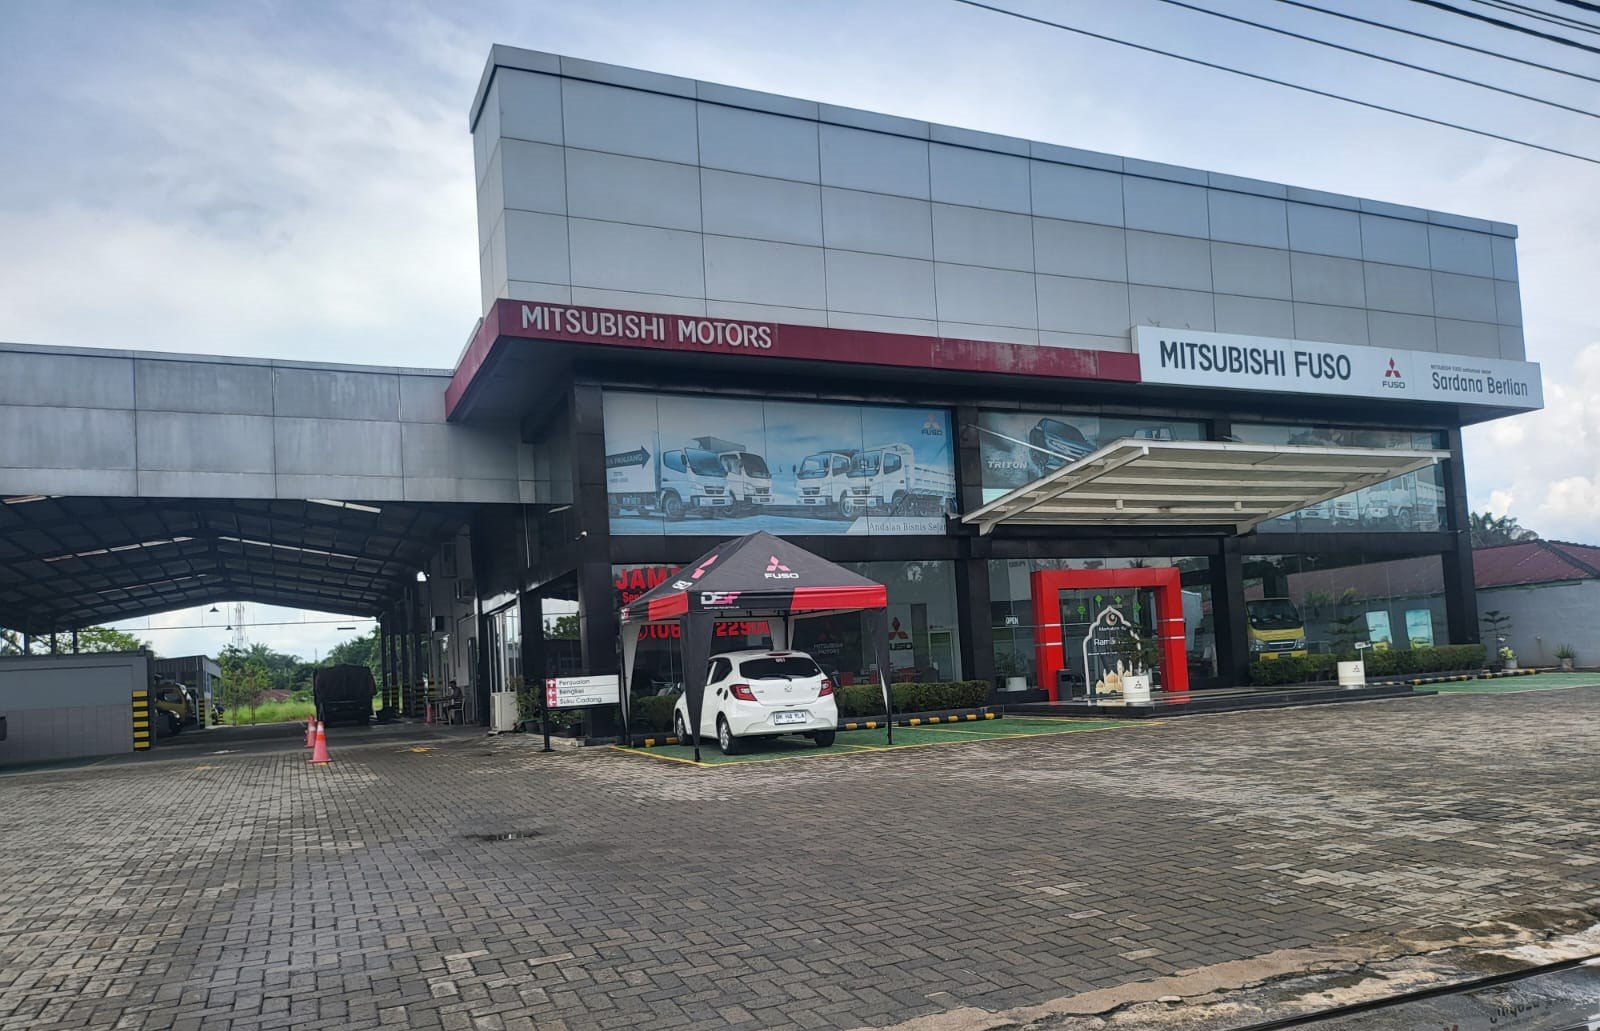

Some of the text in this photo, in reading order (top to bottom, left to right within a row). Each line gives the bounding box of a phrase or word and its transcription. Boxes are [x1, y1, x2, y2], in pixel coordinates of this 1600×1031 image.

[521, 304, 772, 349] MITSUBISHI MOTORS
[1159, 340, 1352, 381] MITSUBISHI FUSO
[1382, 380, 1406, 389] FUSO
[1432, 372, 1529, 396] Sardana Berlian
[987, 459, 1028, 470] TRITON
[869, 522, 901, 531] Andalan
[1005, 616, 1019, 625] OPEN
[889, 642, 913, 651] USO
